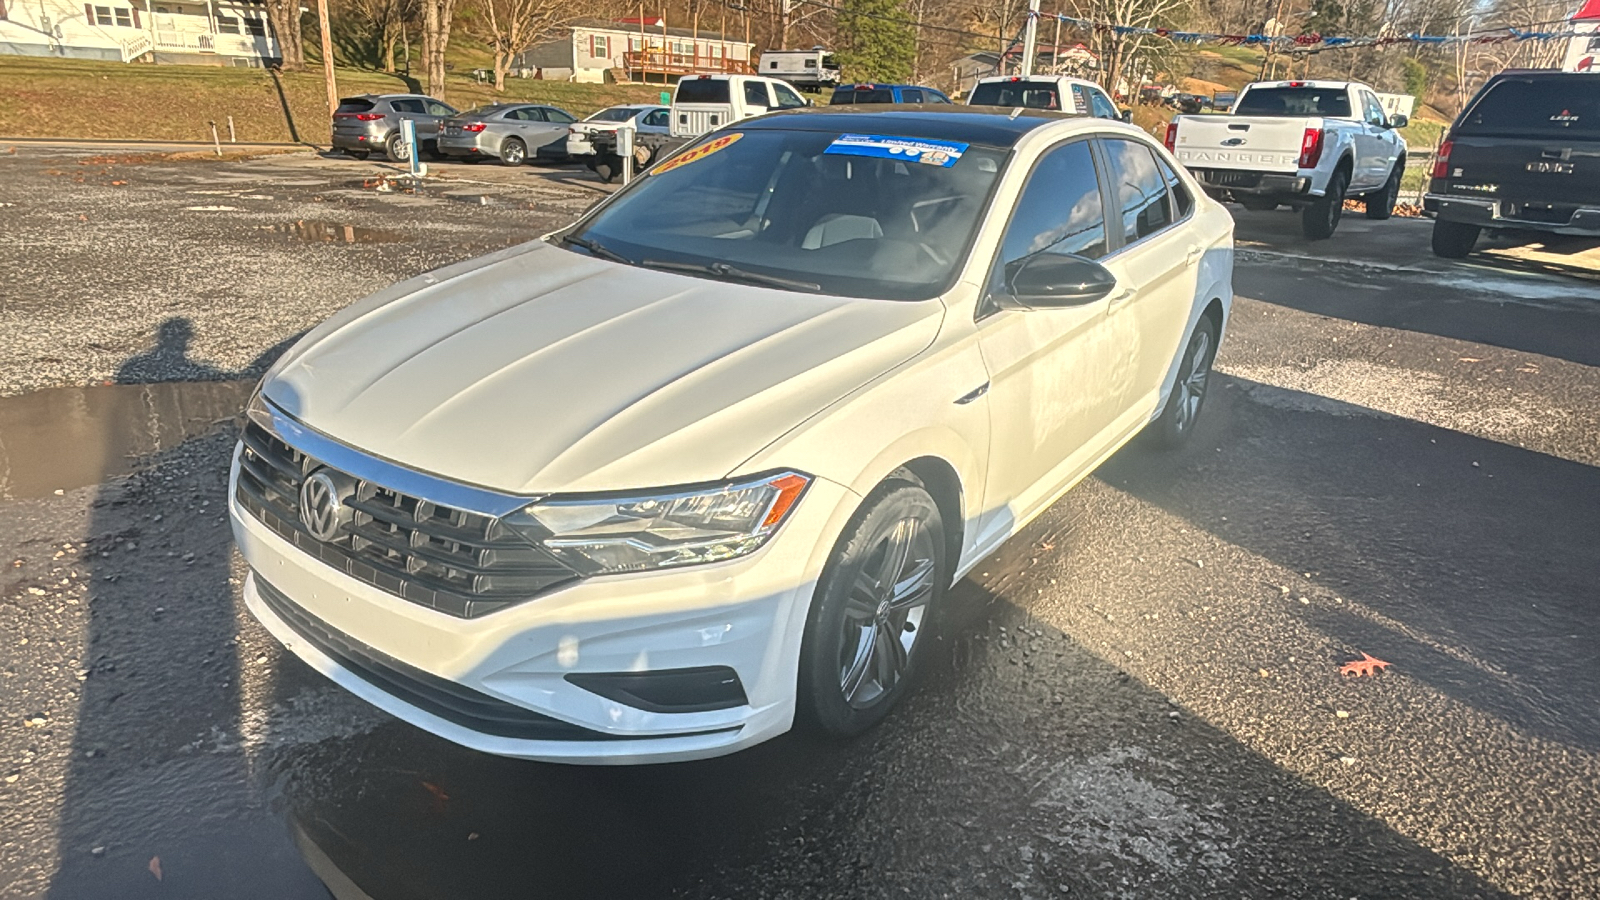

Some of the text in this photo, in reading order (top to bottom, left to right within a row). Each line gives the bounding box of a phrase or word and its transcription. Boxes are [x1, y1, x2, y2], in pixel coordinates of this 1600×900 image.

[881, 139, 958, 153] Limited Warranty
[662, 137, 732, 171] 2019
[1176, 151, 1297, 164] RANGER
[1526, 162, 1574, 173] GMC
